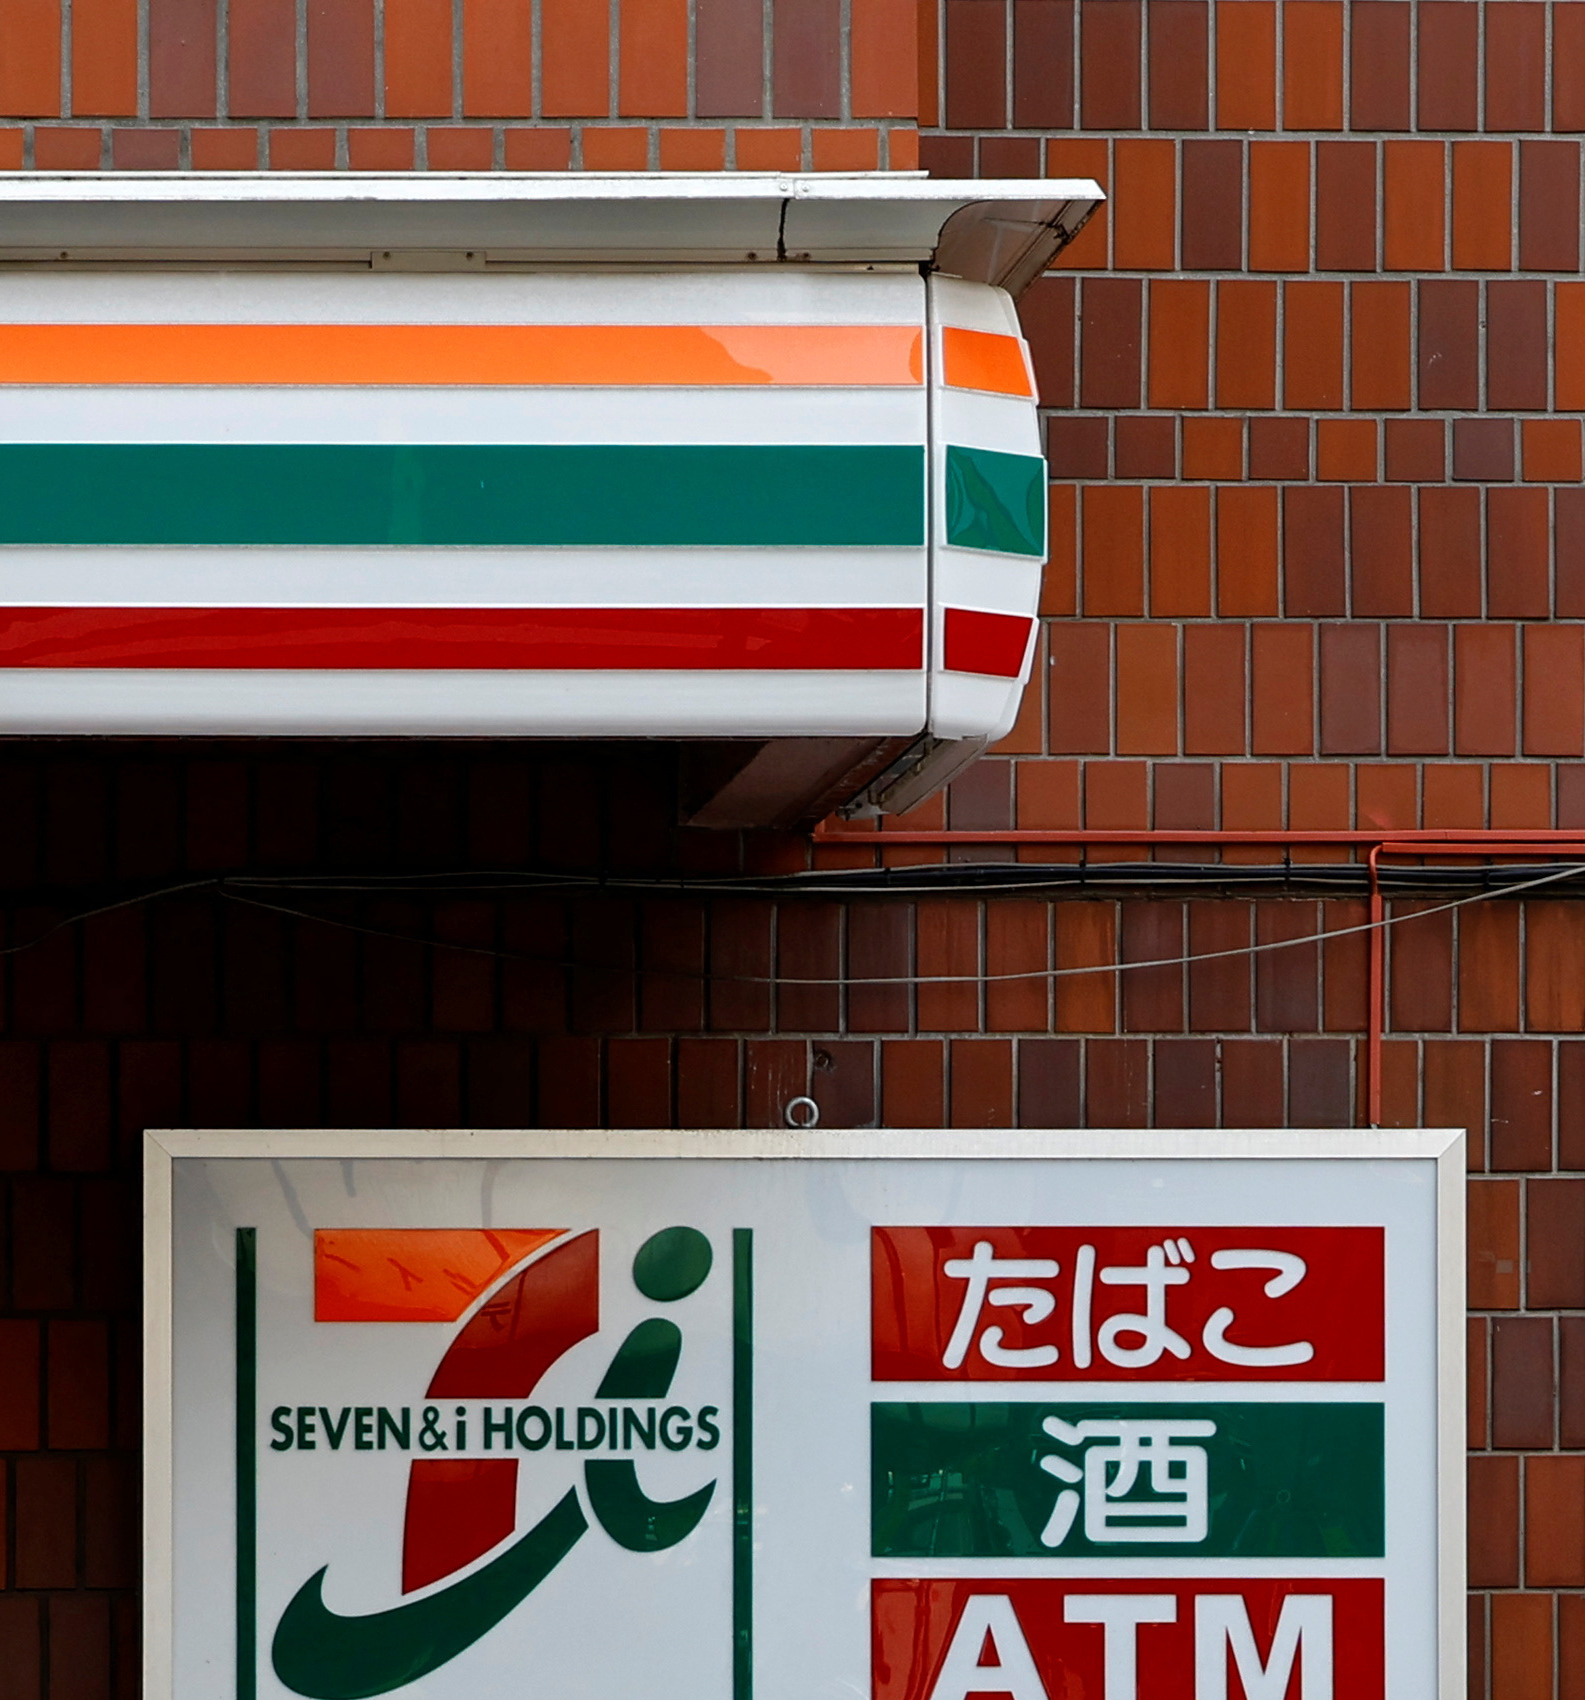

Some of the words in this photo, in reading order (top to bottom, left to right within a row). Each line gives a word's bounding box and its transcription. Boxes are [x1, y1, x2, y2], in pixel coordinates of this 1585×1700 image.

[940, 1237, 1315, 1370] たばこ
[483, 1405, 721, 1453] HOLDINGS
[1040, 1414, 1218, 1549] 酒
